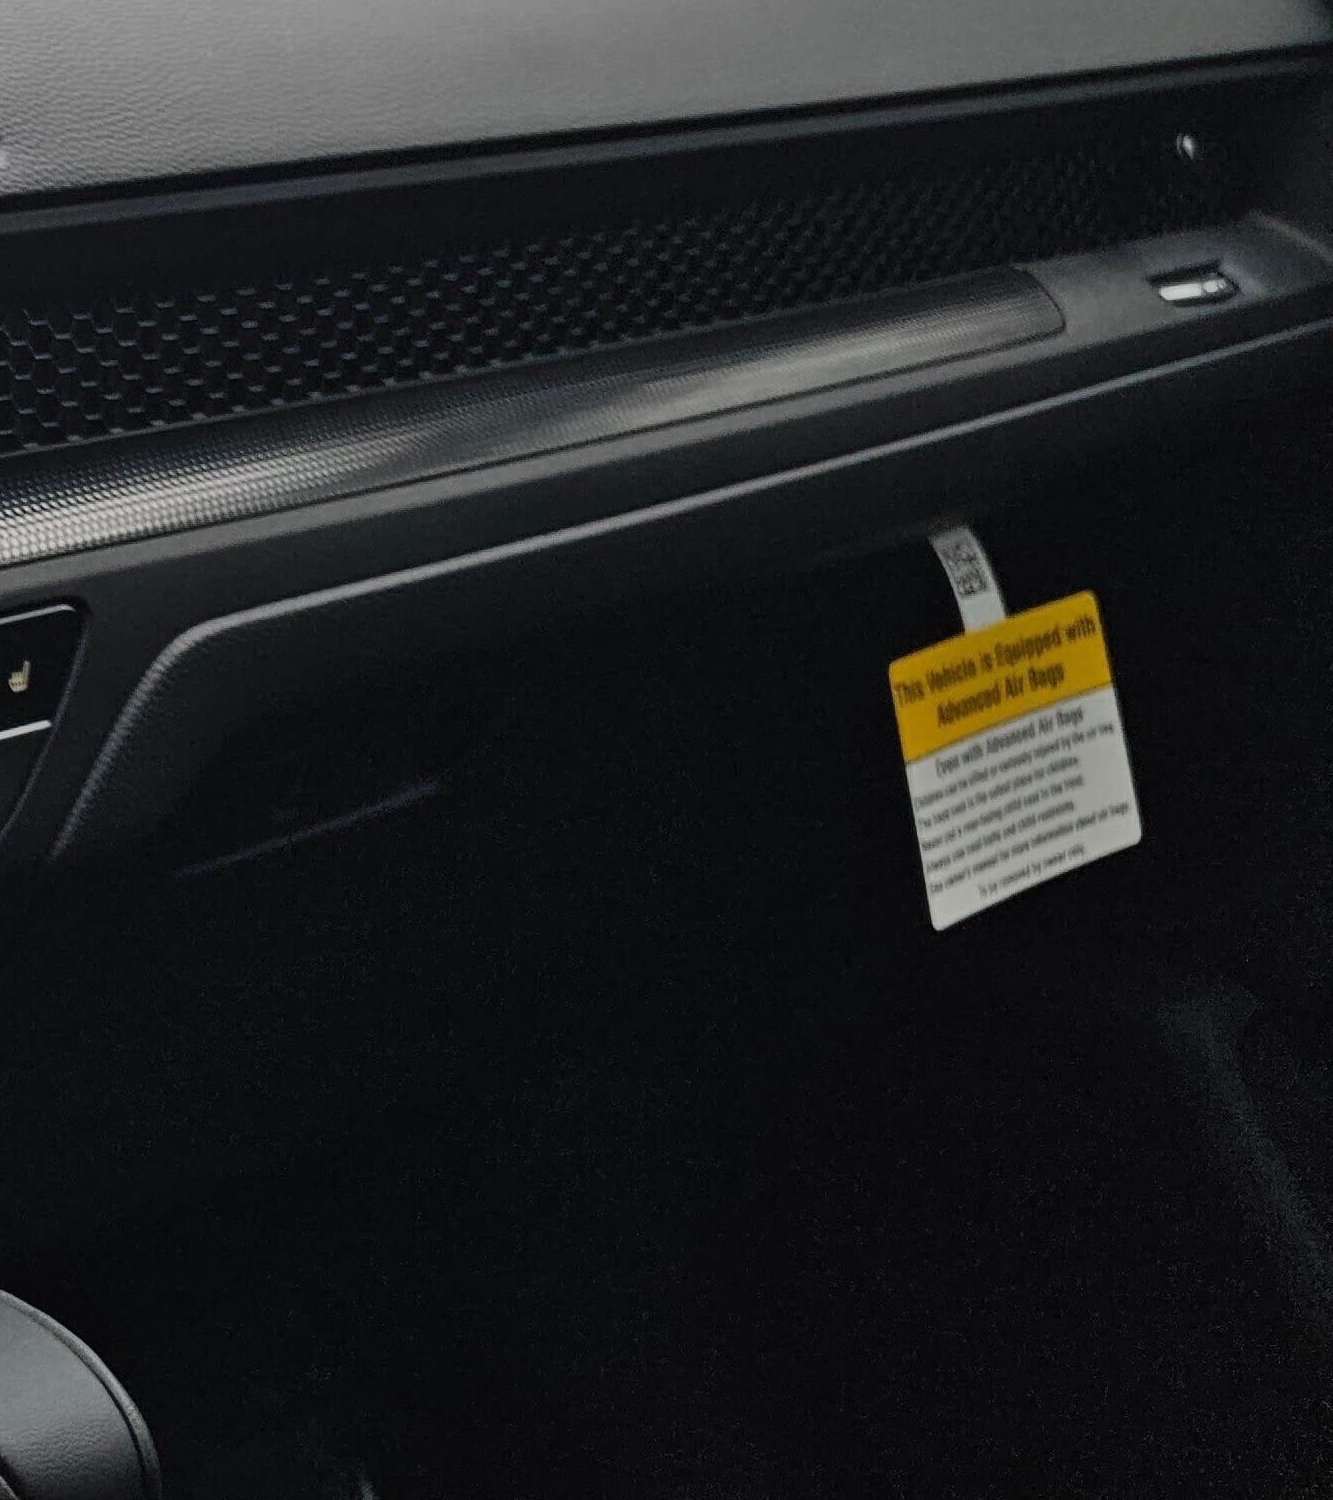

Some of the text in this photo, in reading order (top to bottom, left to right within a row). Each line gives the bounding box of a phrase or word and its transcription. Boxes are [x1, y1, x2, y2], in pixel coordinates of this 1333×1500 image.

[892, 613, 1097, 706] This Vehicle is Equipped with
[937, 663, 1066, 728] Advanced Air Bags
